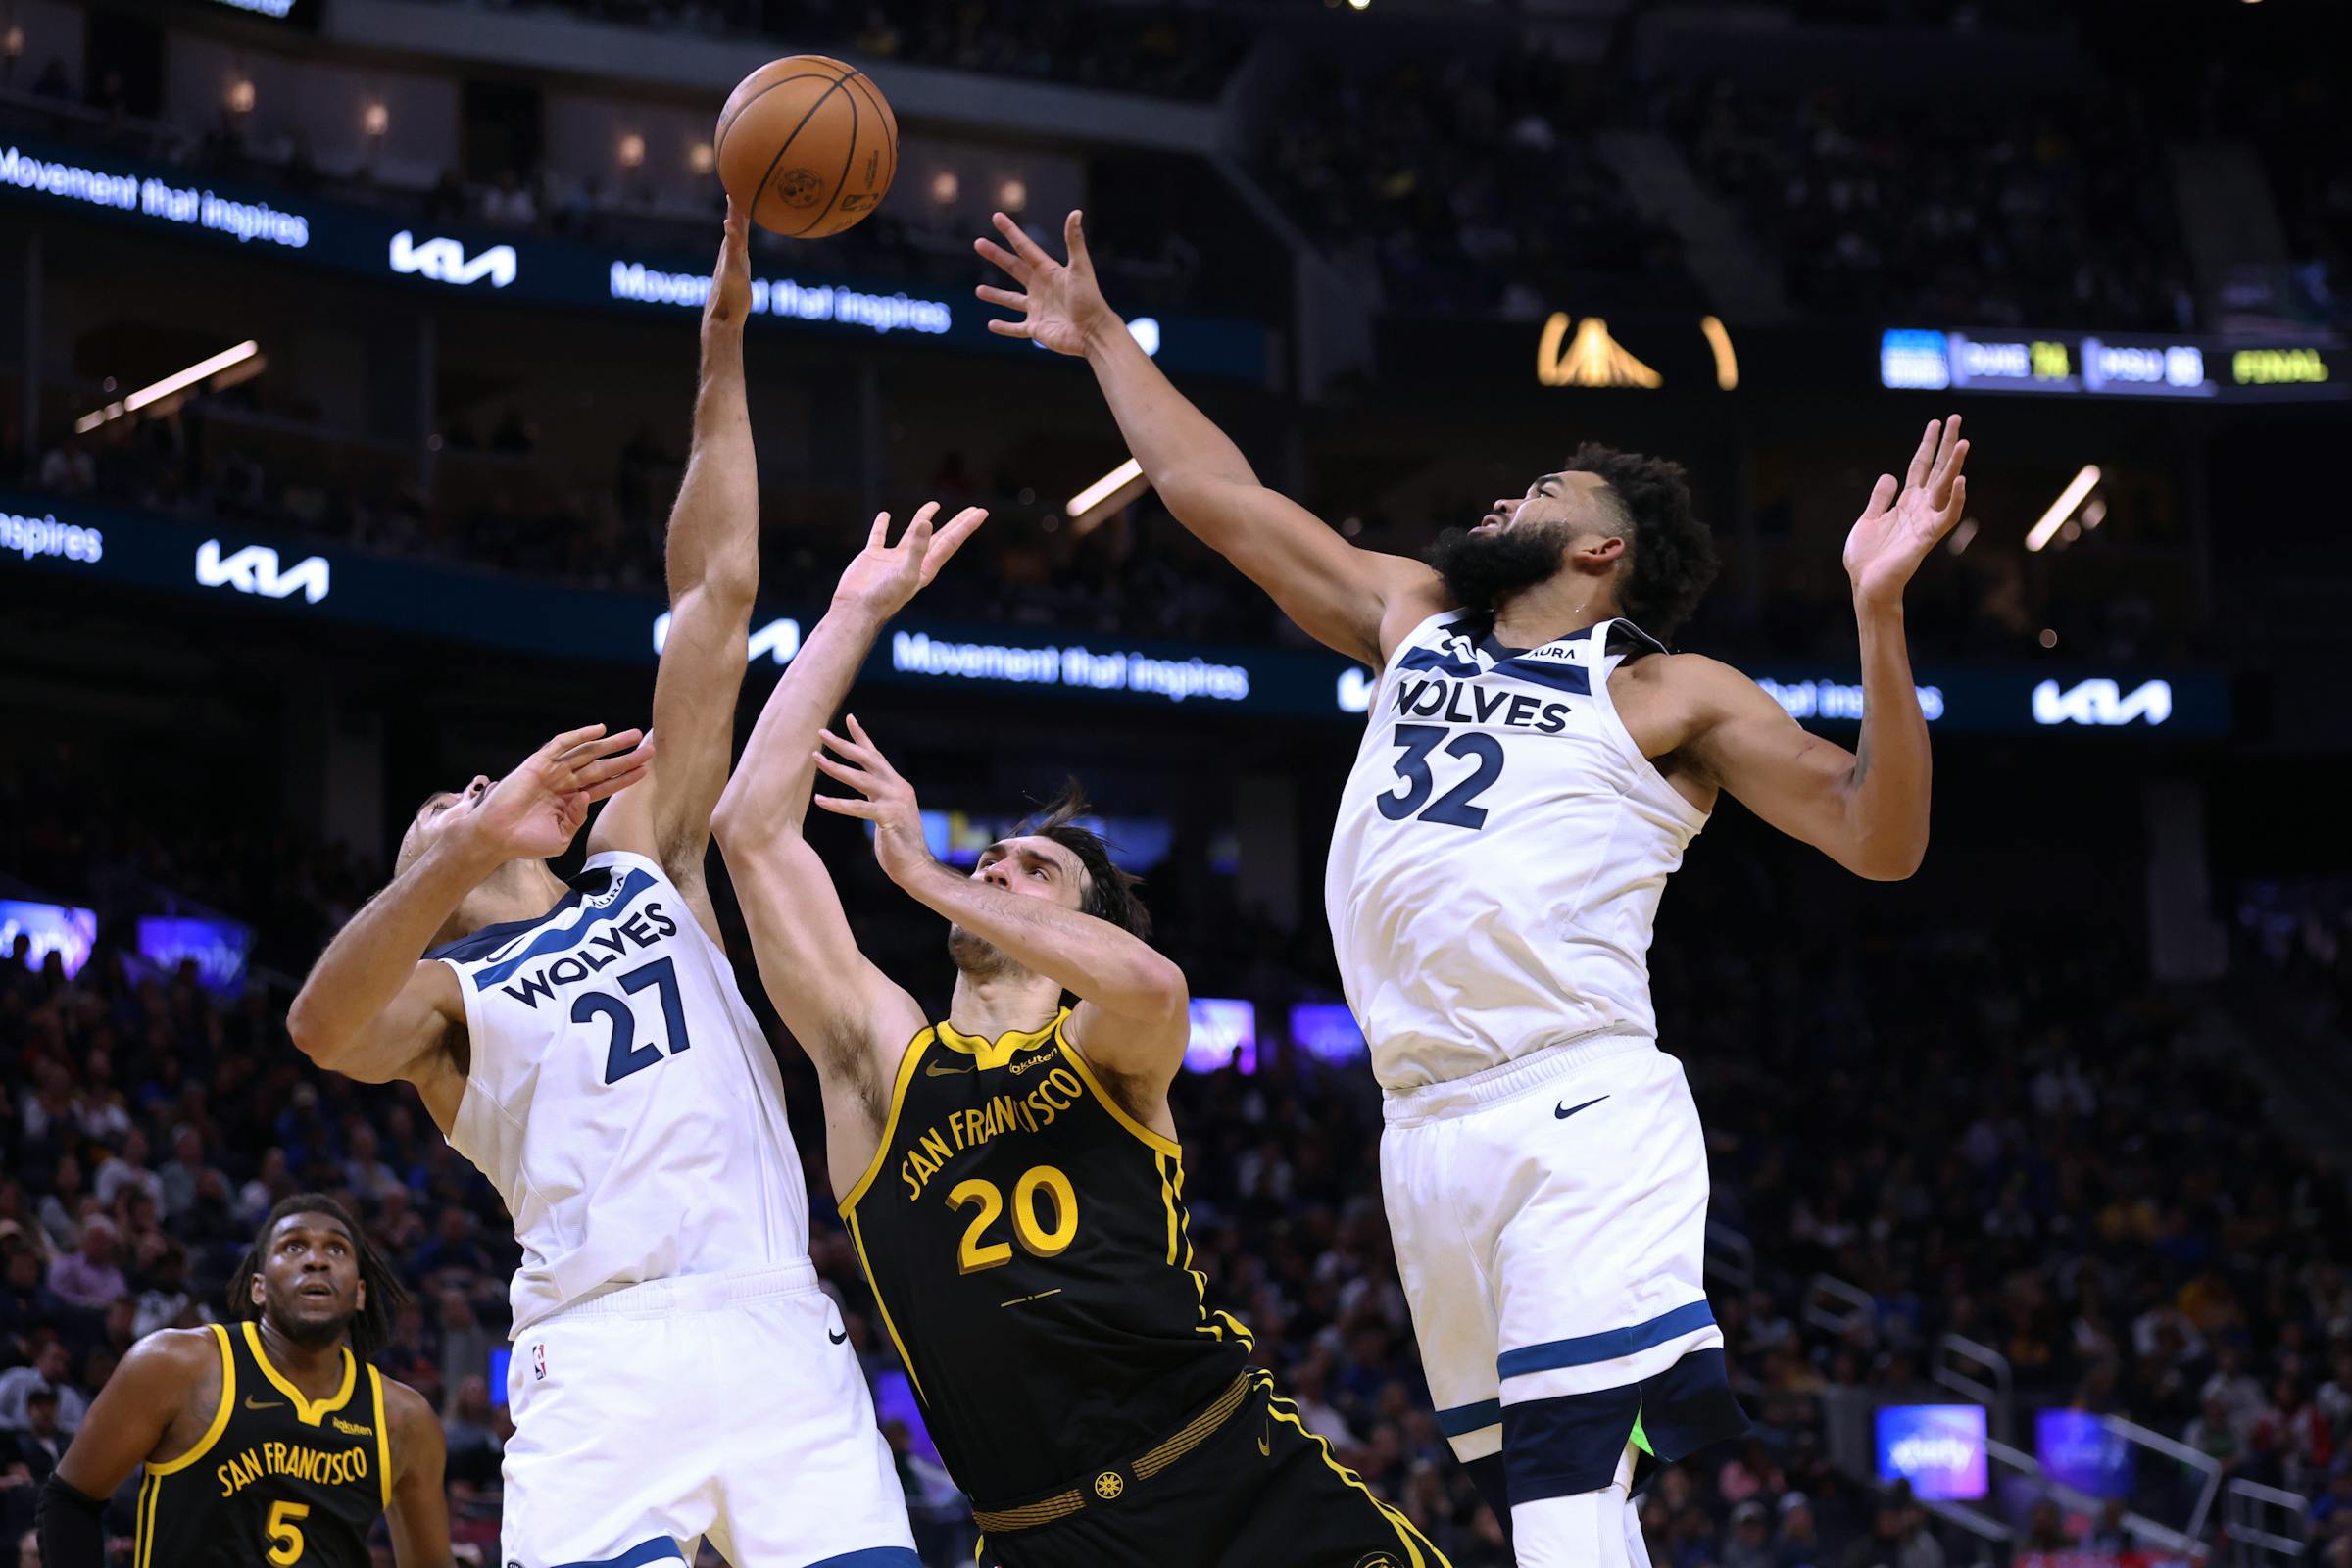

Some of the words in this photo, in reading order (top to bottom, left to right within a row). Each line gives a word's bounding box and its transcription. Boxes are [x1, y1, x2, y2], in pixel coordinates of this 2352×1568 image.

[140, 178, 199, 223] that
[200, 190, 309, 248] inspires
[611, 260, 770, 314] Movemt
[771, 279, 834, 320] that
[834, 286, 952, 334] inspires
[2232, 348, 2329, 384] FINAL
[893, 631, 1061, 683] Movement
[1061, 646, 1127, 690] that
[1127, 652, 1250, 702] inspires
[1391, 679, 1572, 733] WOLVES
[1376, 723, 1504, 831] 32
[501, 903, 677, 1009] WOLVES
[570, 956, 691, 1085] 27
[1009, 1047, 1058, 1076] akuten
[902, 1127, 954, 1201] SAN
[944, 1164, 1079, 1276] 20
[217, 1447, 264, 1497] SAN
[263, 1441, 368, 1486] FRANCISCO
[265, 1499, 310, 1568] 5
